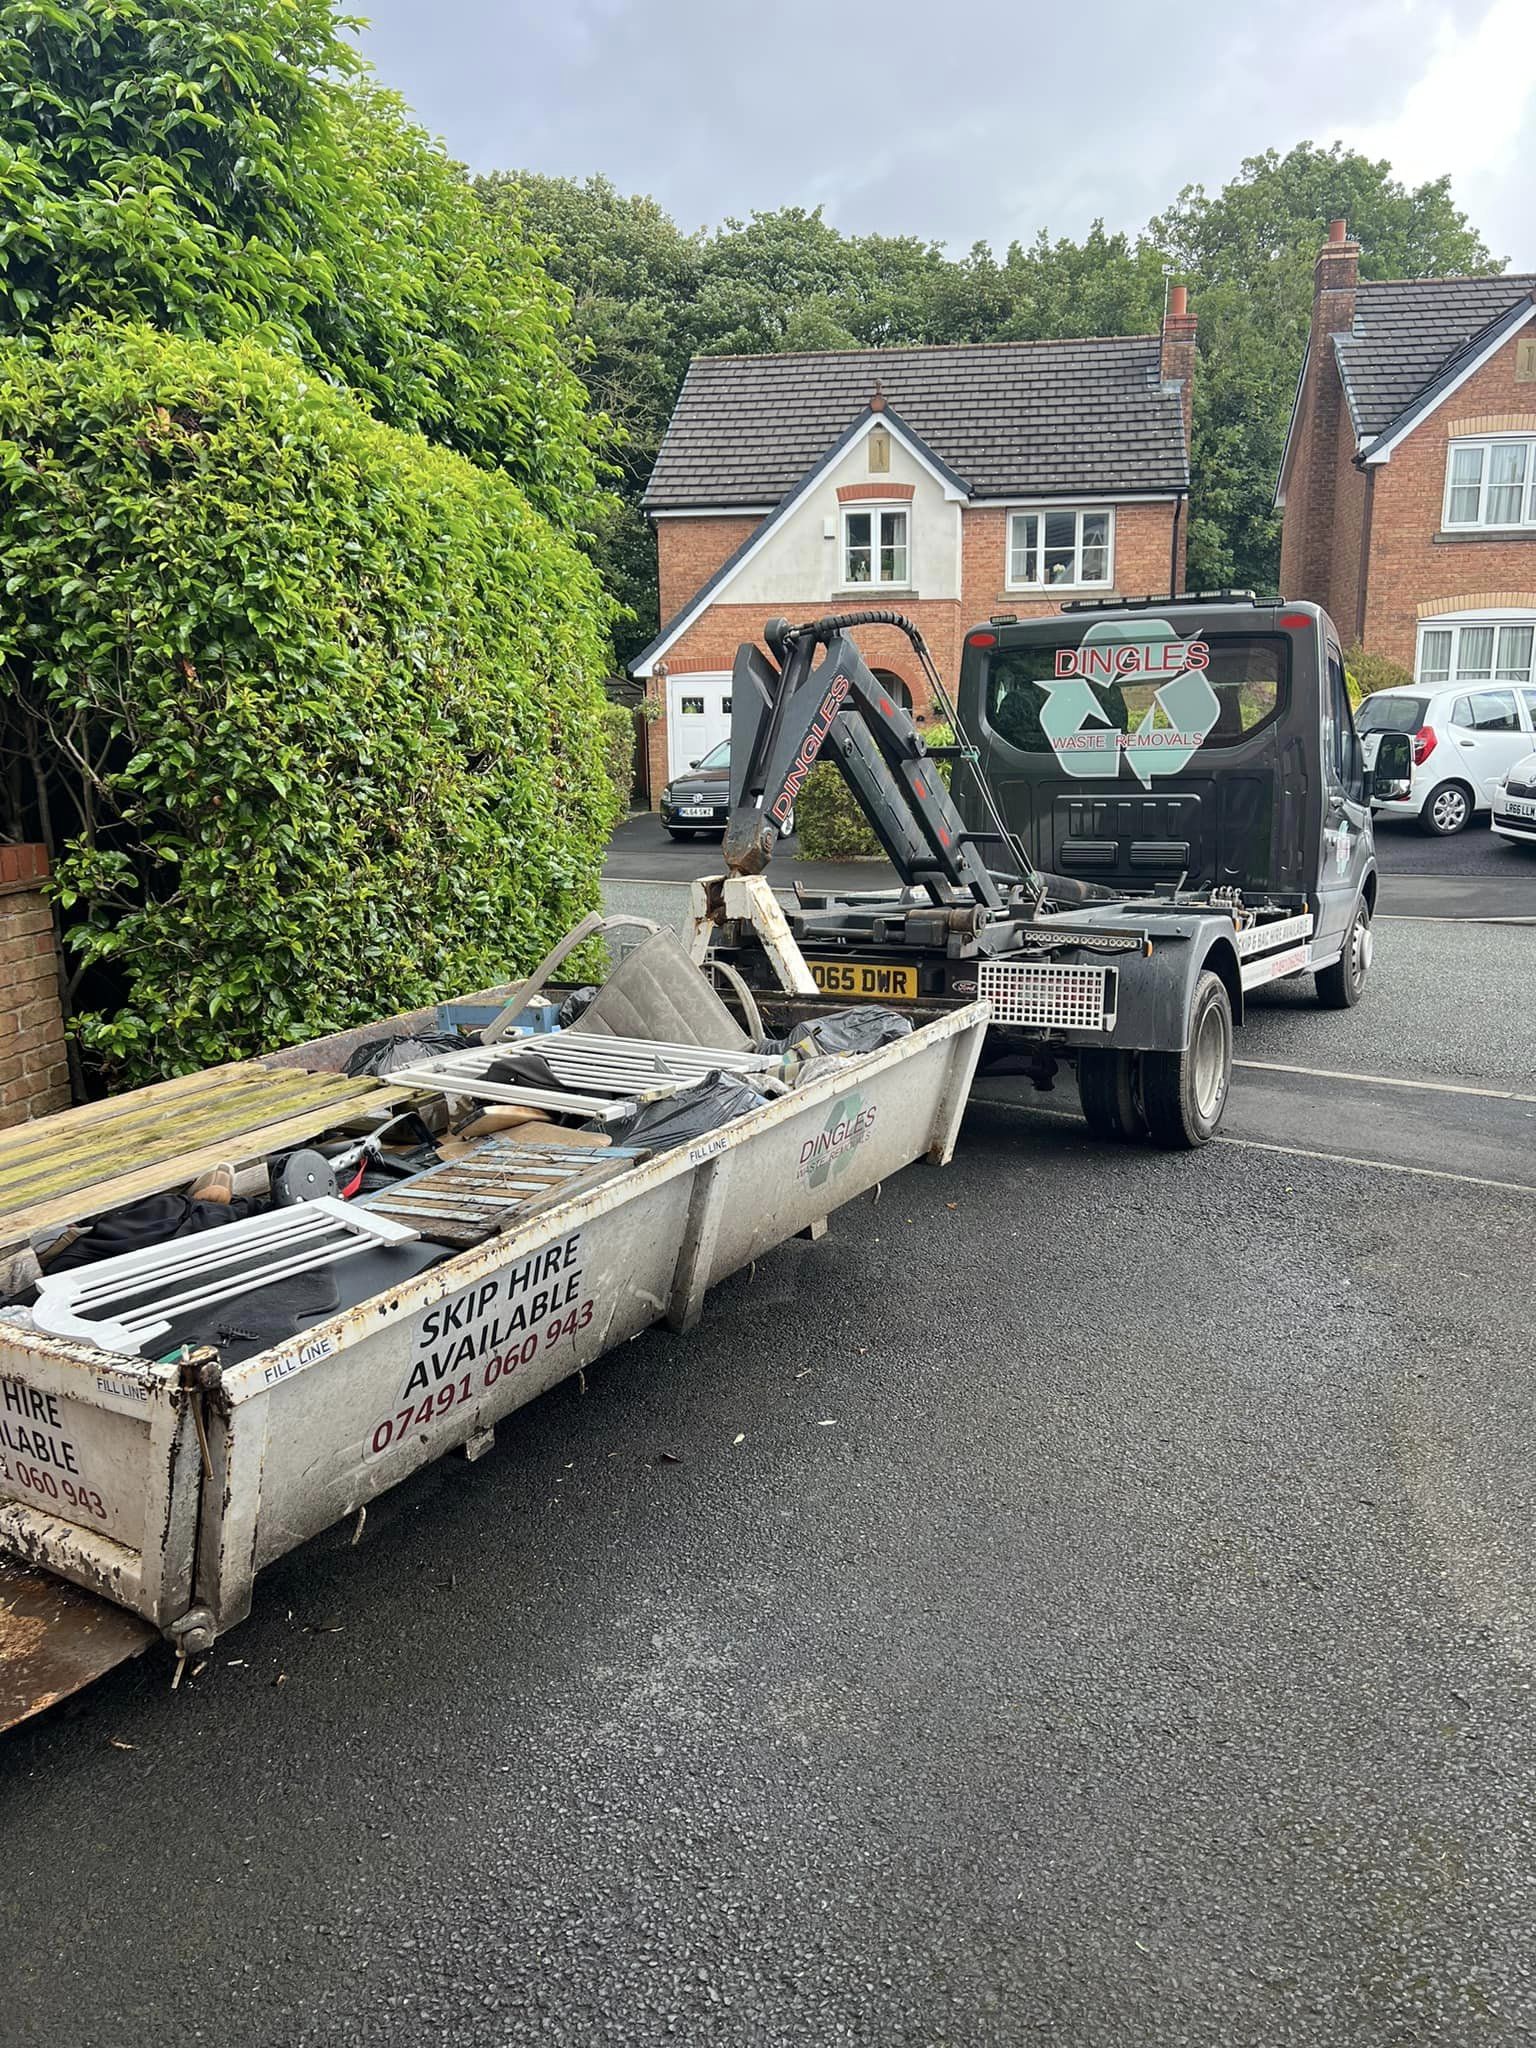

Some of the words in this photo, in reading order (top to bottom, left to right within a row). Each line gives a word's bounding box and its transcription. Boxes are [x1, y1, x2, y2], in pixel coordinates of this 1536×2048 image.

[1054, 641, 1210, 678] DINGLES
[772, 674, 849, 822] DINGLES
[1052, 734, 1105, 750] WASTE
[1115, 731, 1204, 748] REMOVALS
[809, 965, 855, 992] O65
[862, 968, 907, 995] DWR
[690, 1148, 707, 1162] FILL
[708, 1137, 728, 1155] LINE
[800, 1106, 877, 1165] DINGLES
[419, 1281, 498, 1349] SKIP
[507, 1233, 581, 1300] HIRE
[402, 1269, 583, 1401] AVAILABLE
[264, 1359, 296, 1383] FILL
[299, 1338, 331, 1365] LINE
[371, 1373, 473, 1454] 07491
[483, 1333, 538, 1387] 060
[544, 1299, 594, 1350] 943
[2, 1380, 62, 1429] HIRE
[96, 1377, 120, 1395] FILL
[121, 1383, 148, 1401] LINE
[16, 1461, 59, 1499] 060
[61, 1479, 108, 1520] 943
